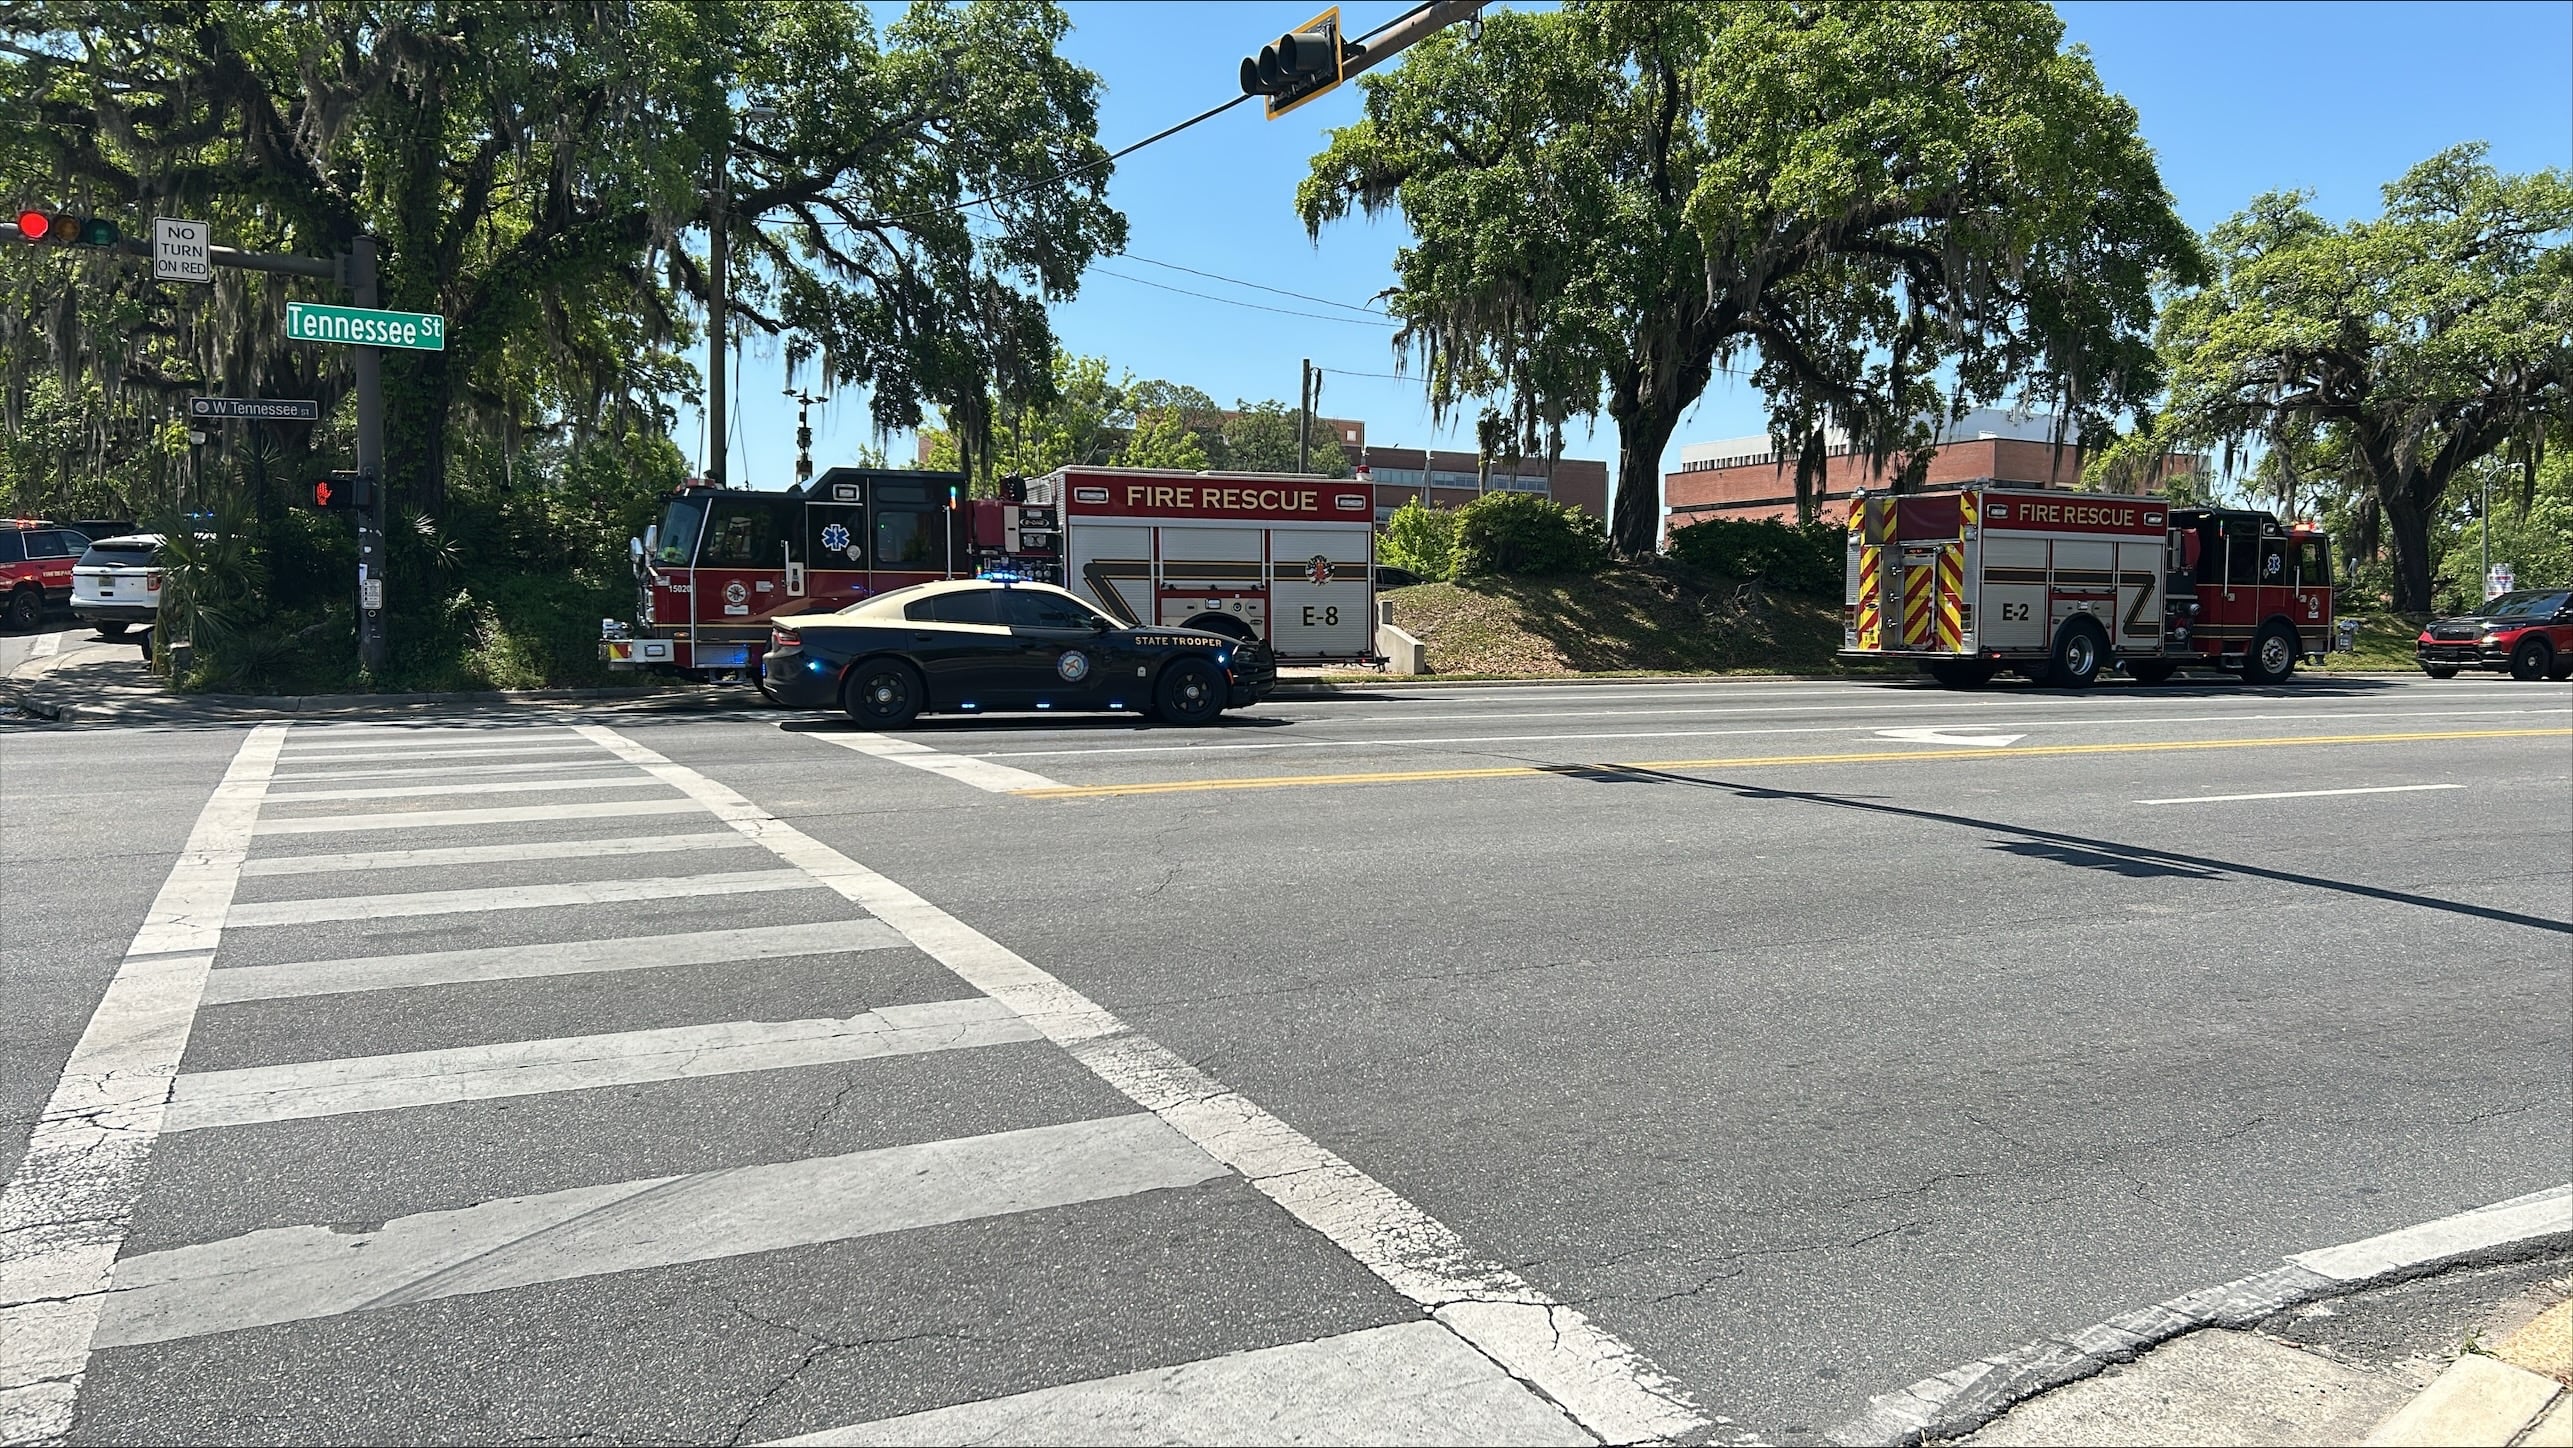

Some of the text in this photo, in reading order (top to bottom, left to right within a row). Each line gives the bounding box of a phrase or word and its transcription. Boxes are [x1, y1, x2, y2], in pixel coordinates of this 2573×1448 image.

[168, 226, 195, 240] NO
[160, 242, 203, 257] TURN
[158, 259, 206, 274] ON RED
[288, 305, 441, 345] Tennessee St
[212, 401, 227, 414] W
[230, 401, 298, 416] Tennessee
[1127, 485, 1318, 512] FIRE RESCUE
[2019, 503, 2135, 527] FIRE RESCUE
[1302, 605, 1339, 627] E-8
[2002, 602, 2029, 621] E-2
[1135, 636, 1222, 648] STATE TROOPER
